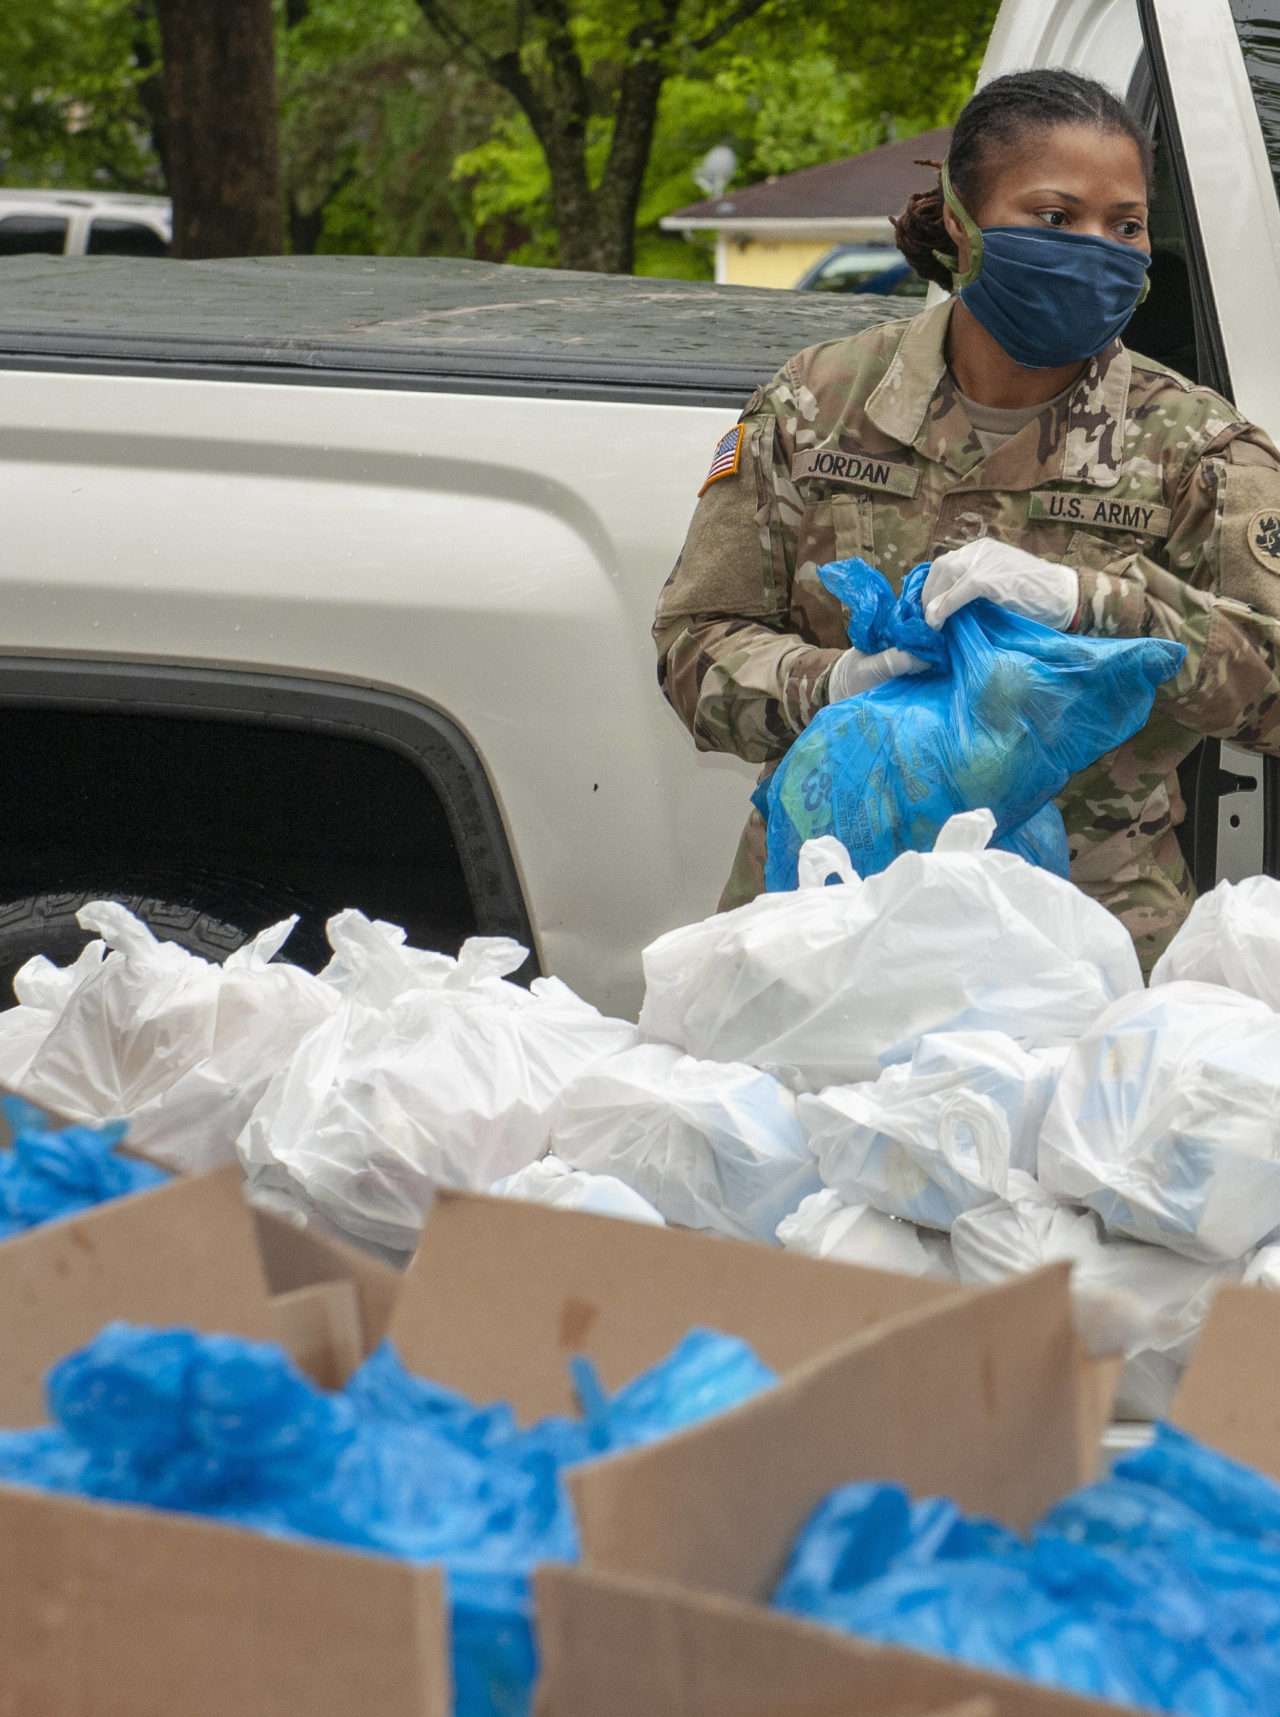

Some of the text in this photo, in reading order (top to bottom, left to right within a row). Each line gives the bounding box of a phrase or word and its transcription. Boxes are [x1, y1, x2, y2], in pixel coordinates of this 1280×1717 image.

[808, 453, 890, 485] JORDAN
[1049, 496, 1155, 529] U.S. ARMY
